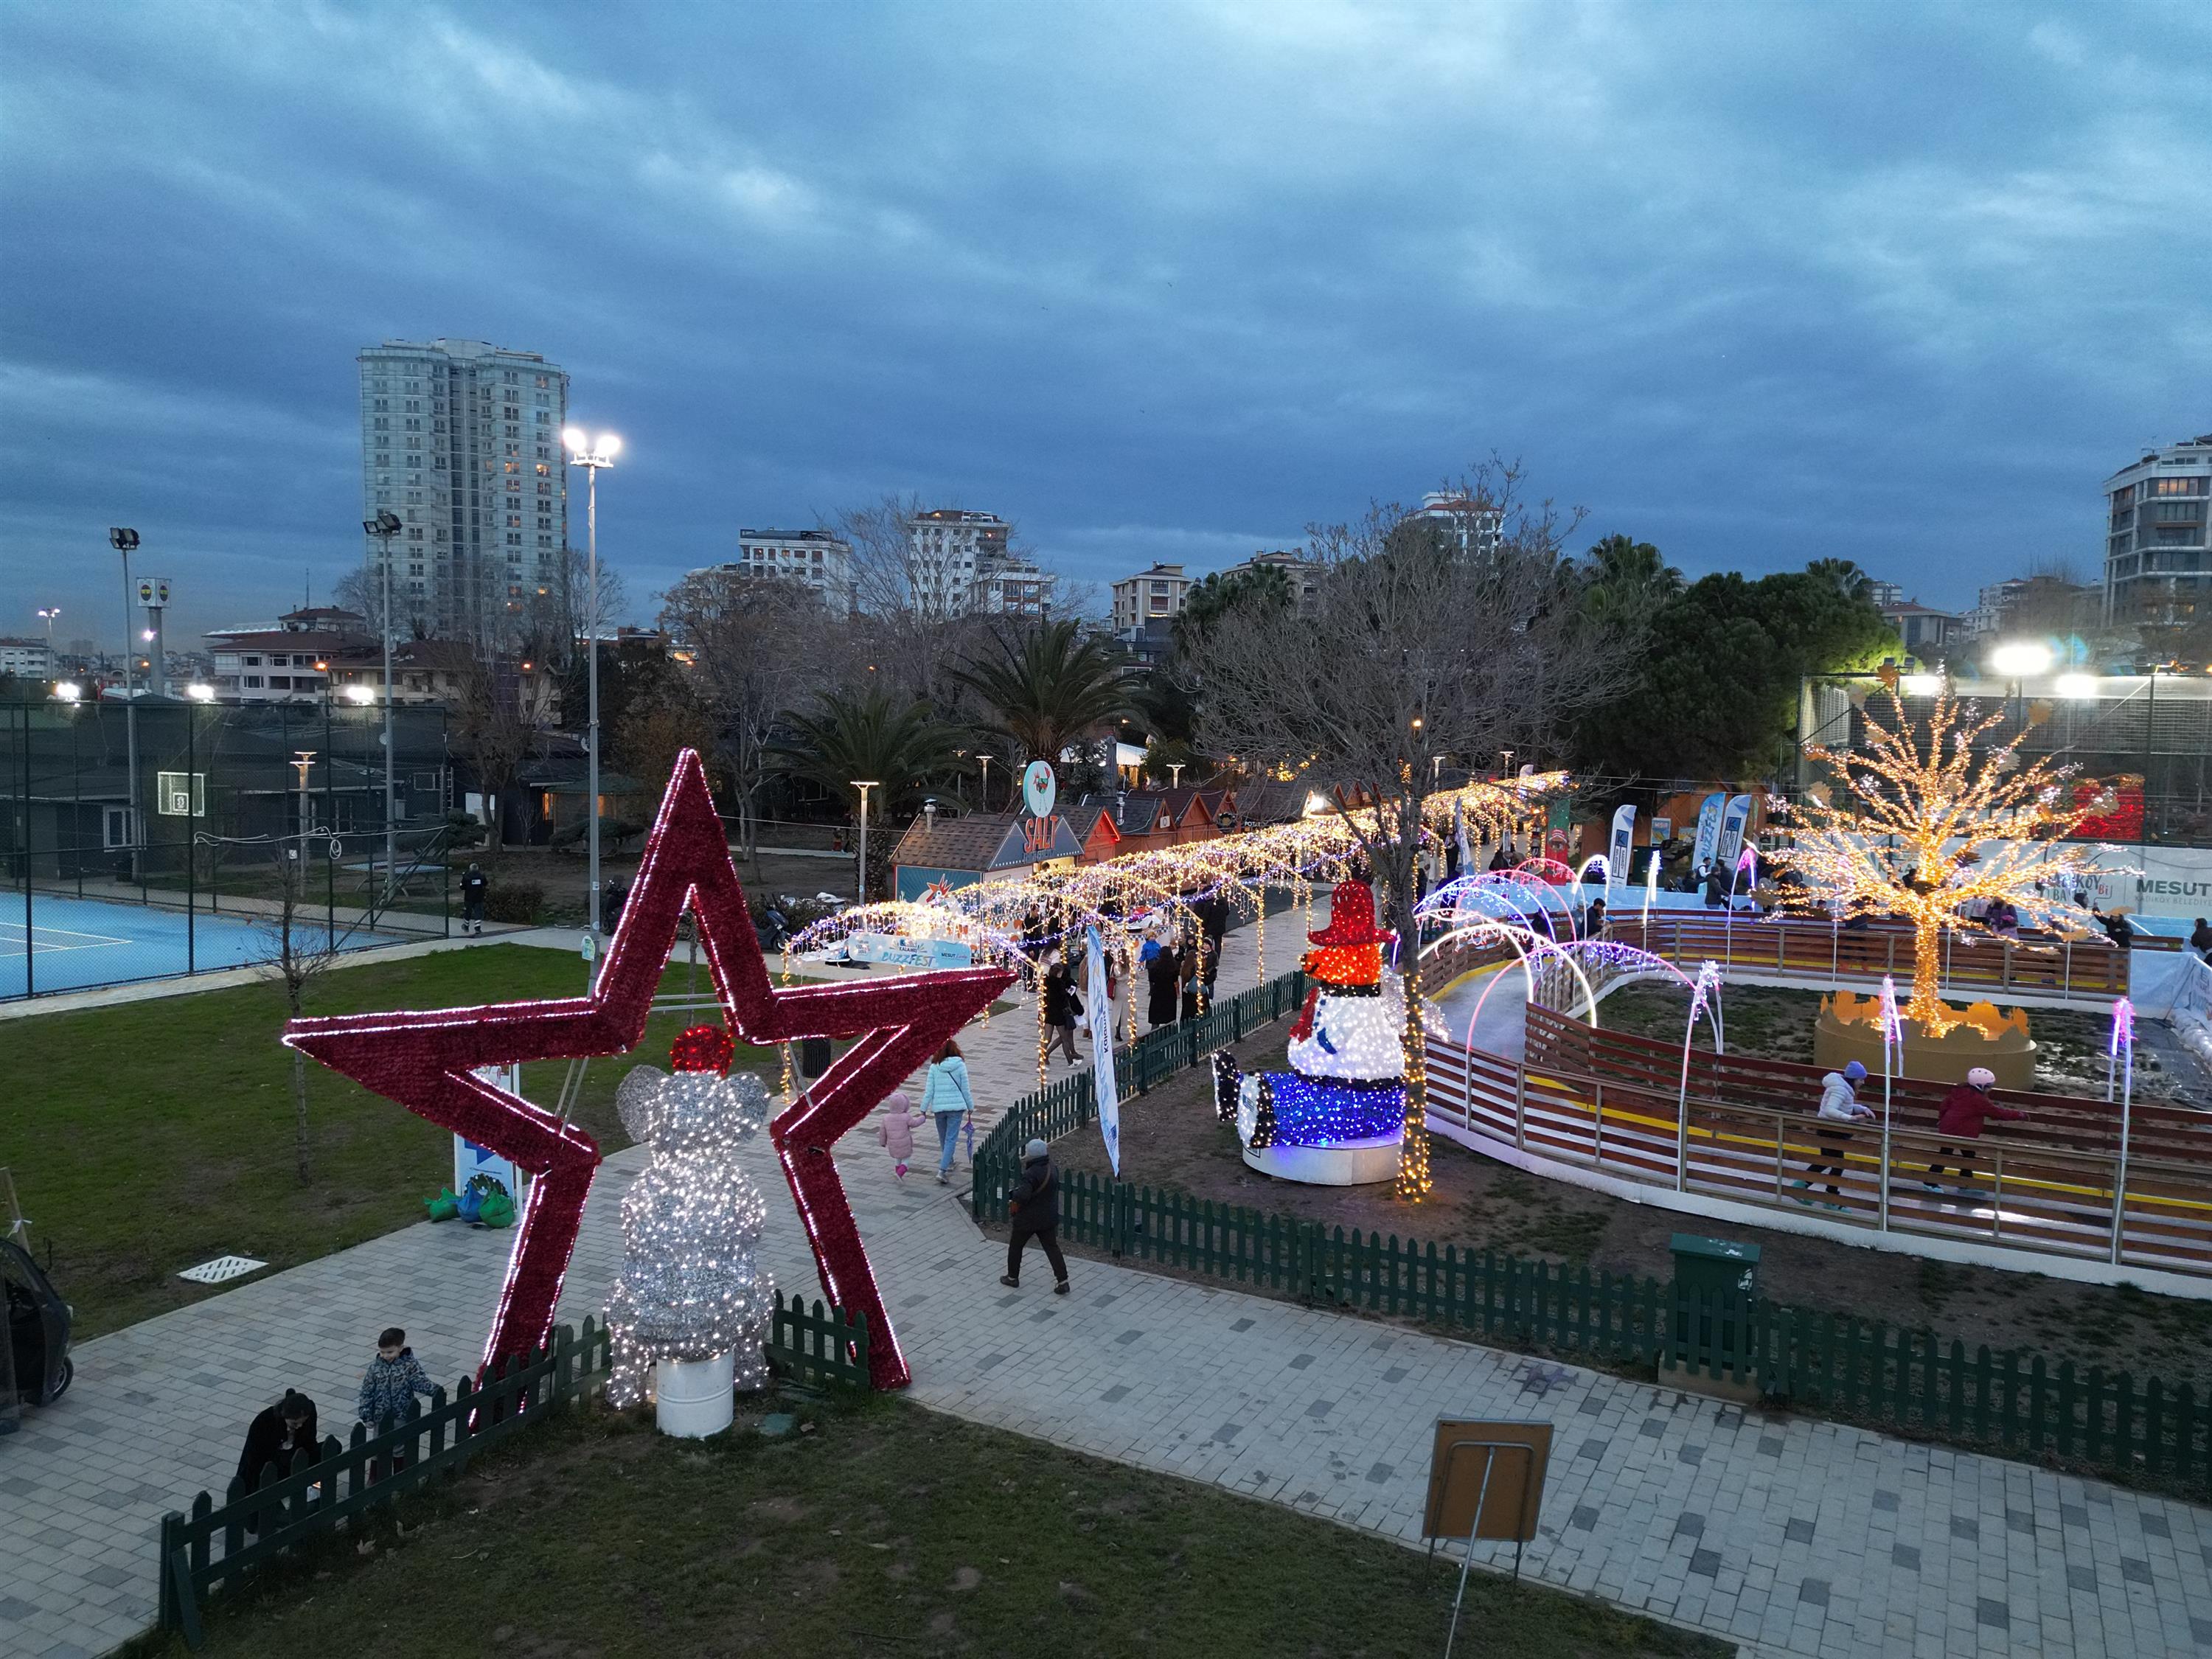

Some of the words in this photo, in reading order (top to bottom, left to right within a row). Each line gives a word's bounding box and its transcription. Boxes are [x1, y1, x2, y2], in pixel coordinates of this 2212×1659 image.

[1023, 815, 1059, 854] SALT
[2136, 879, 2212, 897] MESUT
[881, 951, 936, 967] BUZZFEST
